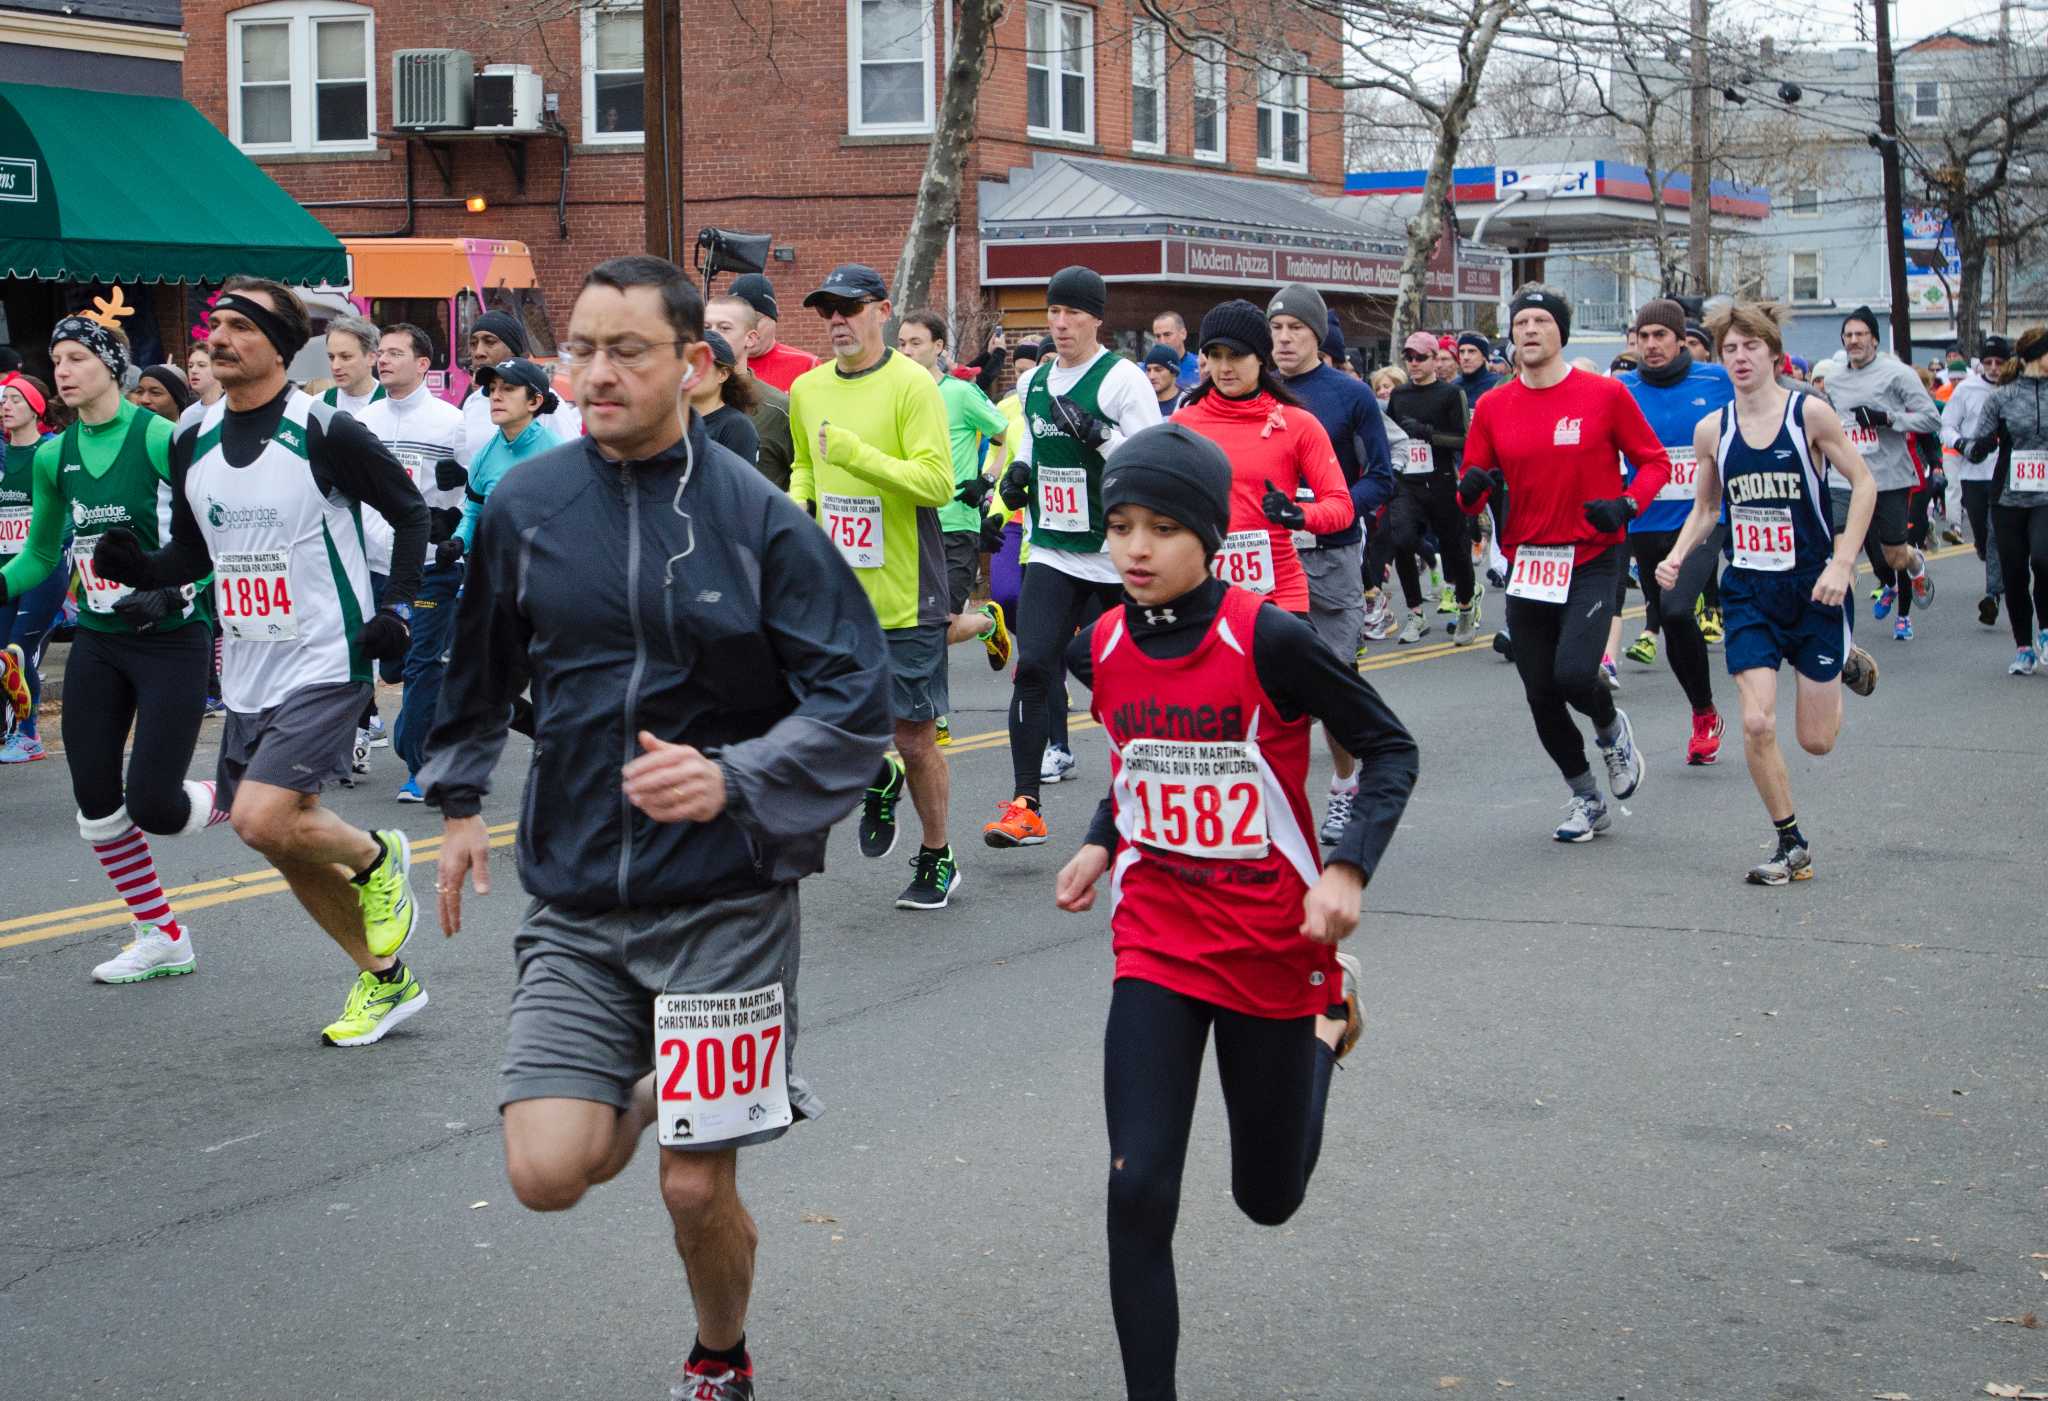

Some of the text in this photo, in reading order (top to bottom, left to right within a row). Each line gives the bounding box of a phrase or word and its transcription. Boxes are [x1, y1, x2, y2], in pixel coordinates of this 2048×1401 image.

[1191, 249, 1269, 277] Modern Apizza
[1286, 256, 1331, 279] Traditional
[1332, 259, 1351, 281] Brick
[1353, 263, 1374, 283] Oven
[1044, 485, 1078, 513] 591
[1728, 472, 1801, 505] CHOATE
[830, 514, 873, 548] 752
[1735, 523, 1792, 553] 1815
[1214, 551, 1263, 583] 785
[1514, 559, 1570, 587] 1089
[222, 576, 292, 616] 1894
[1133, 744, 1247, 760] CHRISTOPHER MARTINS
[1126, 758, 1258, 776] CHRISTMAS RUN FOR CHILDREN
[1135, 780, 1264, 848] 1582
[667, 989, 776, 1012] CHRISTOPHER MARTINS
[658, 1002, 783, 1030] CHRISTMAS RUN FOR CHILDREN
[660, 1025, 781, 1102] 2097
